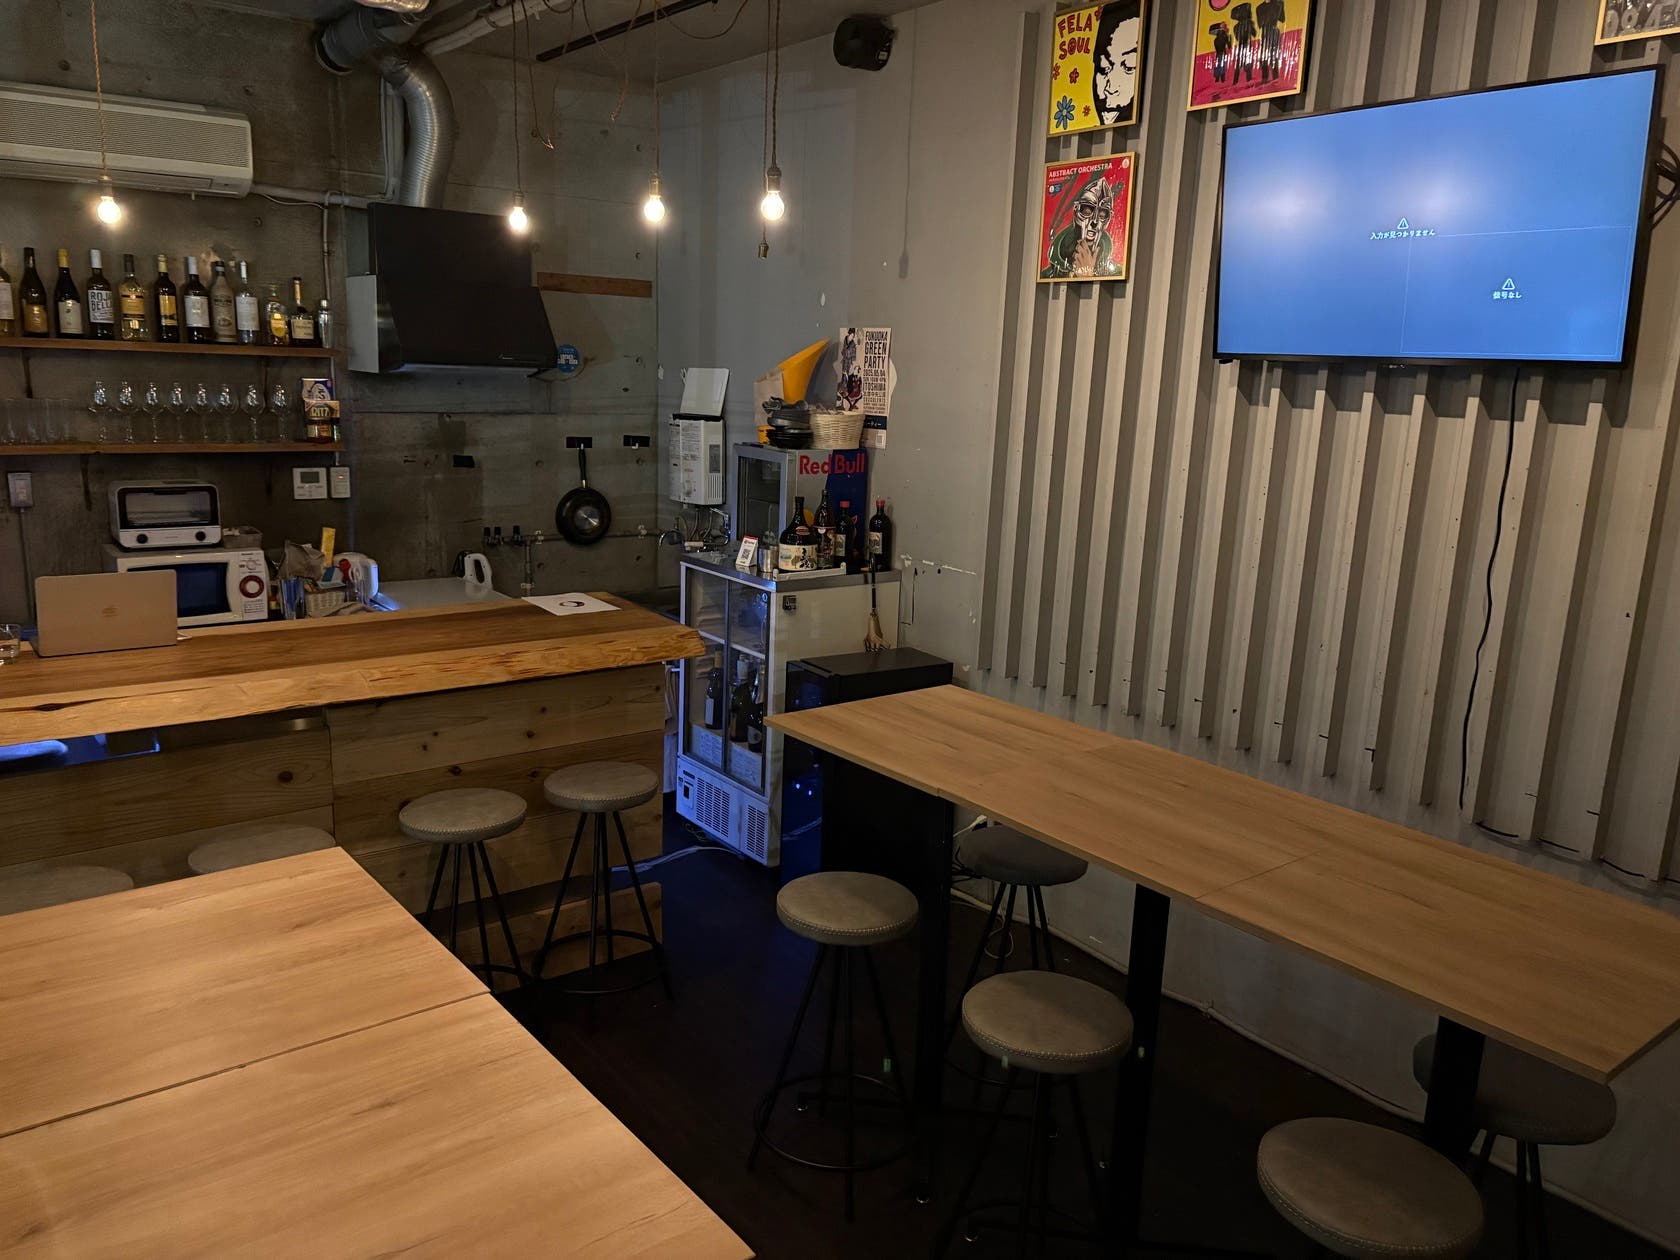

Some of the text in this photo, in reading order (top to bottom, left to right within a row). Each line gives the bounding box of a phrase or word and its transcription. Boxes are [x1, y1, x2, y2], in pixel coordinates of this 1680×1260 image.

[1058, 12, 1092, 38] FELA
[1059, 37, 1091, 60] SOUL
[1049, 162, 1113, 178] ABSTRACT ORCHESTRA
[1370, 229, 1436, 240] 入力が見つかりません
[1493, 291, 1522, 300] 信号なし
[865, 330, 888, 342] FUKUOKA
[864, 341, 887, 355] GREEN
[863, 355, 886, 369] PARTY
[800, 453, 865, 475] Red Bull
